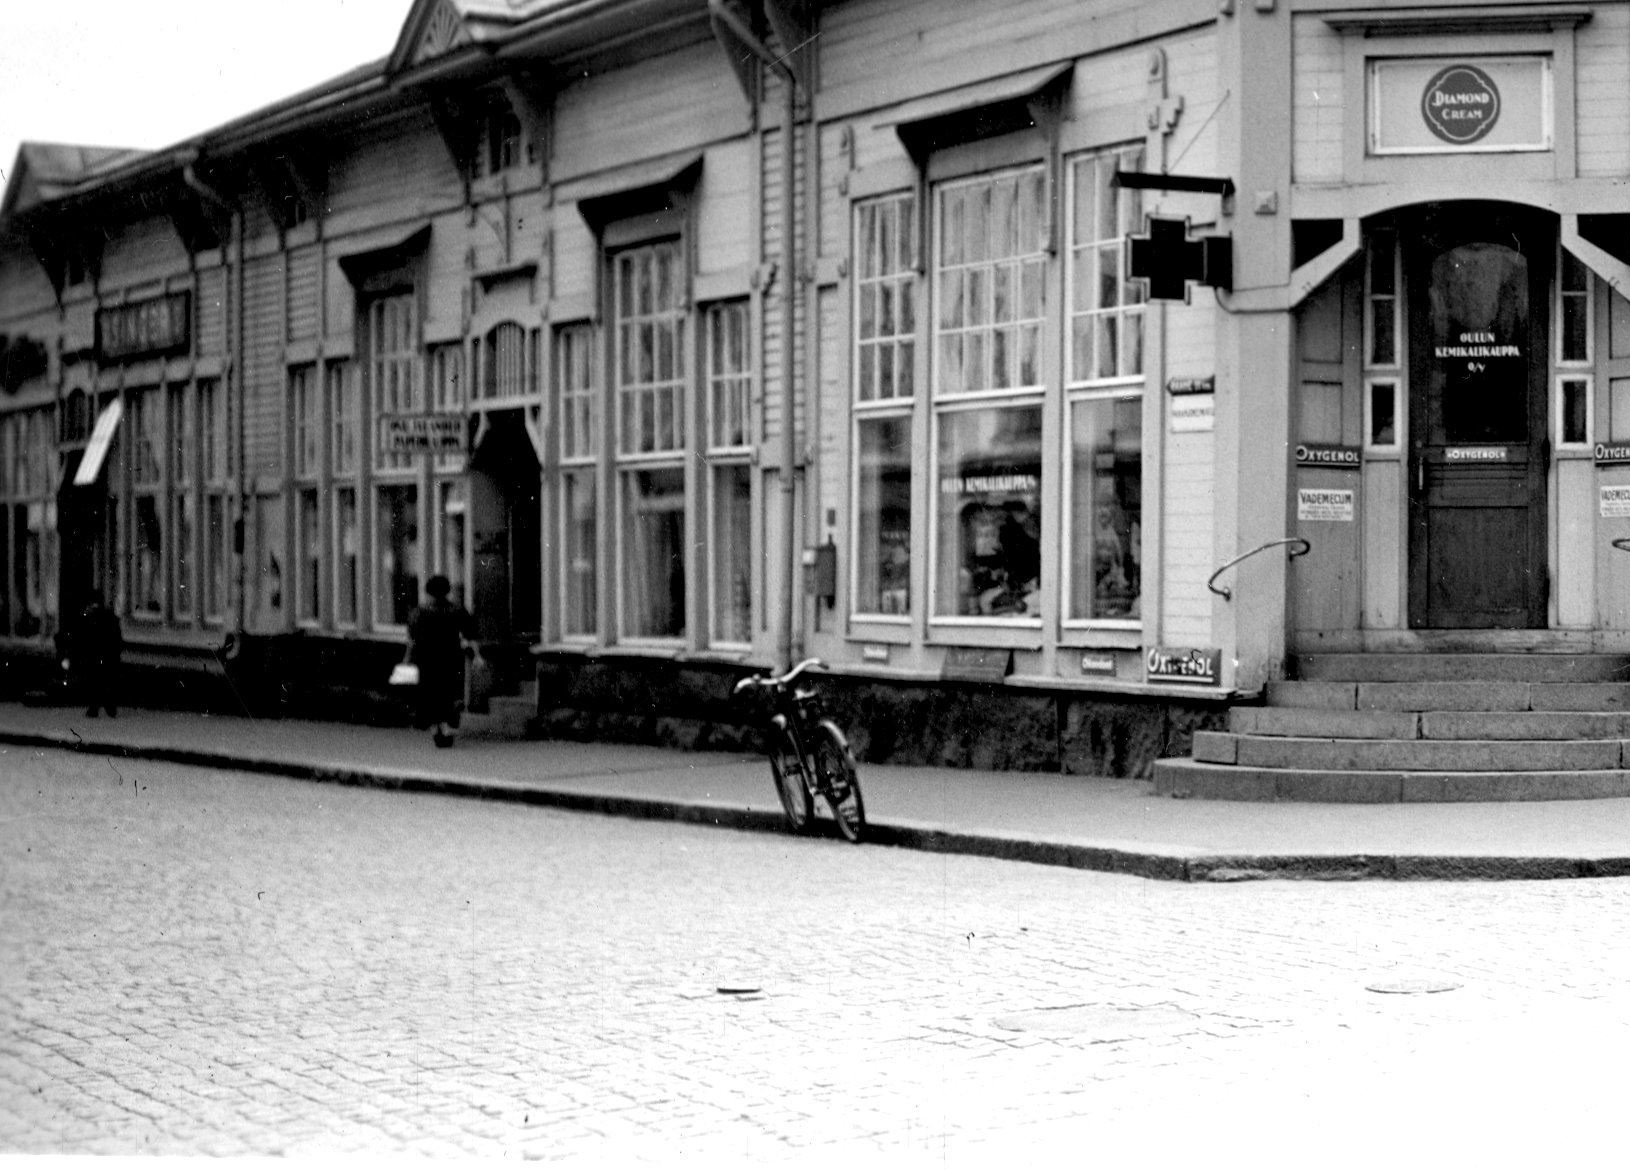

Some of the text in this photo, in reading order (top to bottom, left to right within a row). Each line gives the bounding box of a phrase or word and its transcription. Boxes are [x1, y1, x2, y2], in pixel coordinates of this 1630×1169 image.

[1432, 90, 1489, 107] DIAMOND
[1441, 108, 1482, 120] CREAM
[1459, 332, 1495, 343] OULUN
[1435, 345, 1521, 357] KEMIKALIKAUPPA
[1296, 445, 1359, 462] OXYGENOL
[1299, 491, 1352, 505] VADEMECUM
